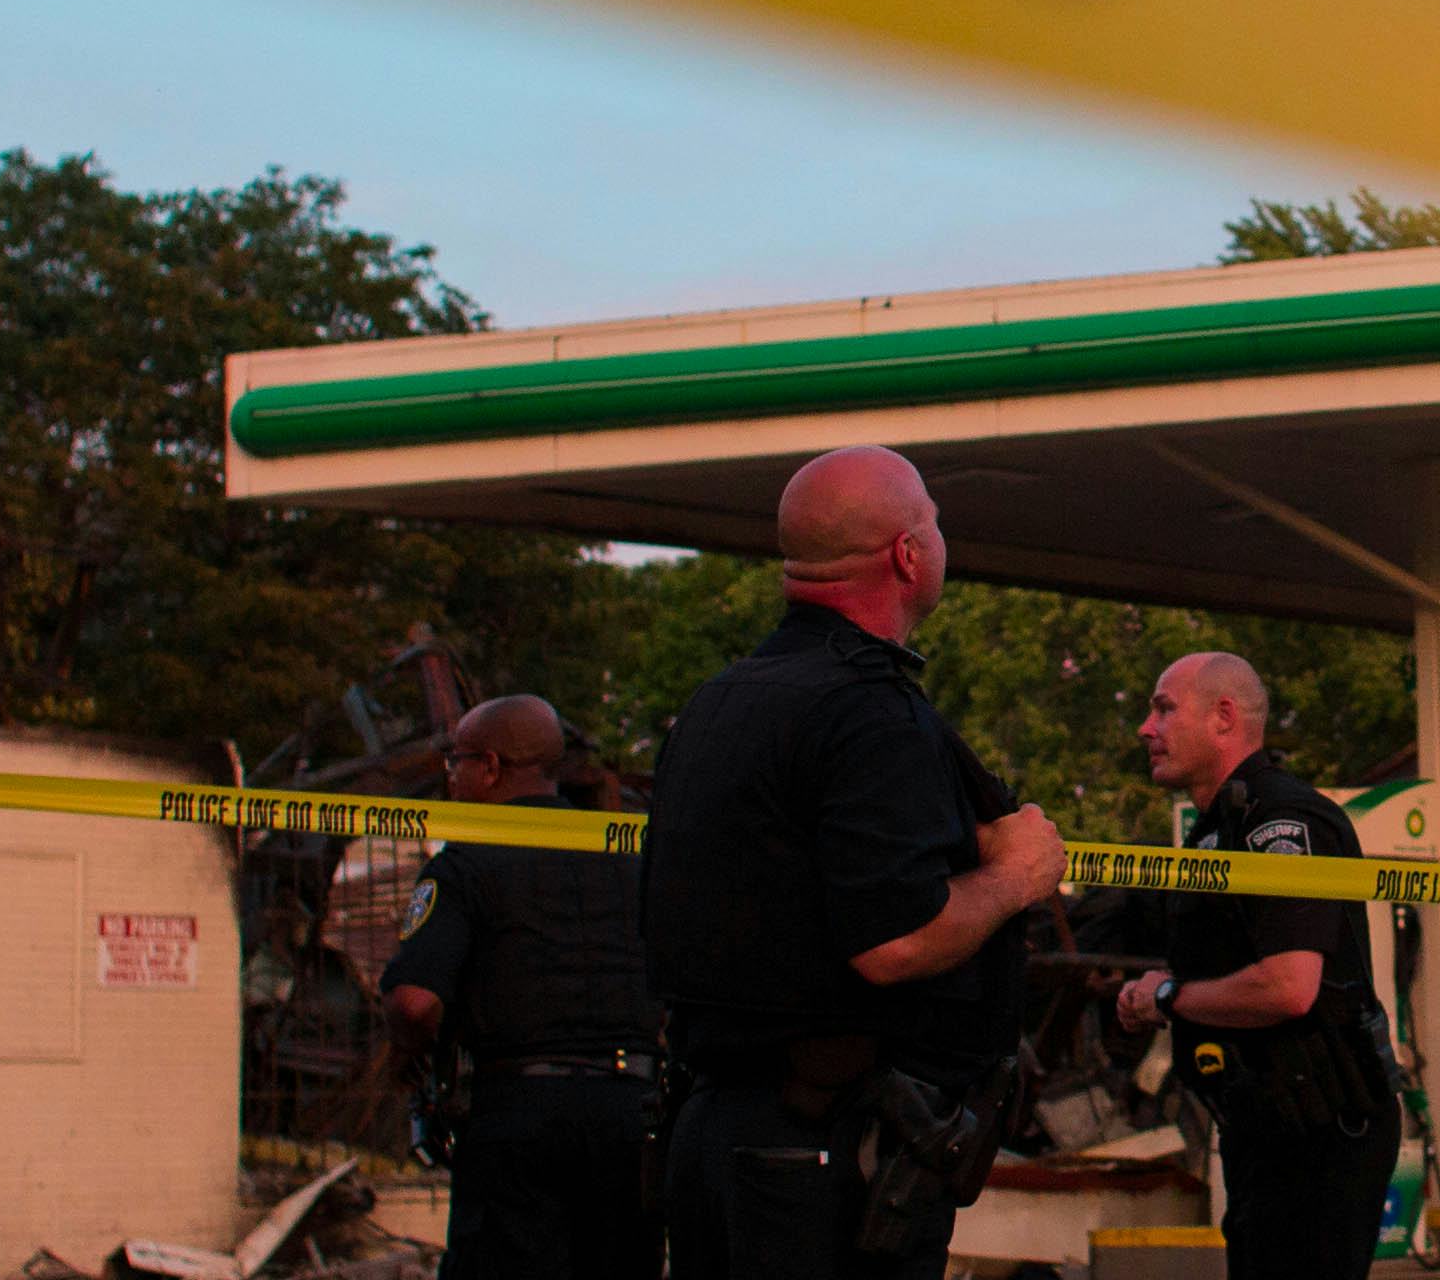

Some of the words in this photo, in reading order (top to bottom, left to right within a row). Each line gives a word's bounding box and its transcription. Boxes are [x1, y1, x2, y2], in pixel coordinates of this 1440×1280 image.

[160, 791, 231, 824] POLICE
[235, 796, 281, 828] LINE
[286, 800, 313, 831] DO
[318, 802, 361, 834] NOT
[364, 805, 429, 839] CROSS
[1252, 823, 1303, 847] SHERIFF
[1071, 851, 1109, 883] LINE
[1112, 854, 1135, 885] DO
[1138, 855, 1175, 888] NOT
[1176, 857, 1231, 891] CROSS
[1373, 869, 1429, 901] POLICE
